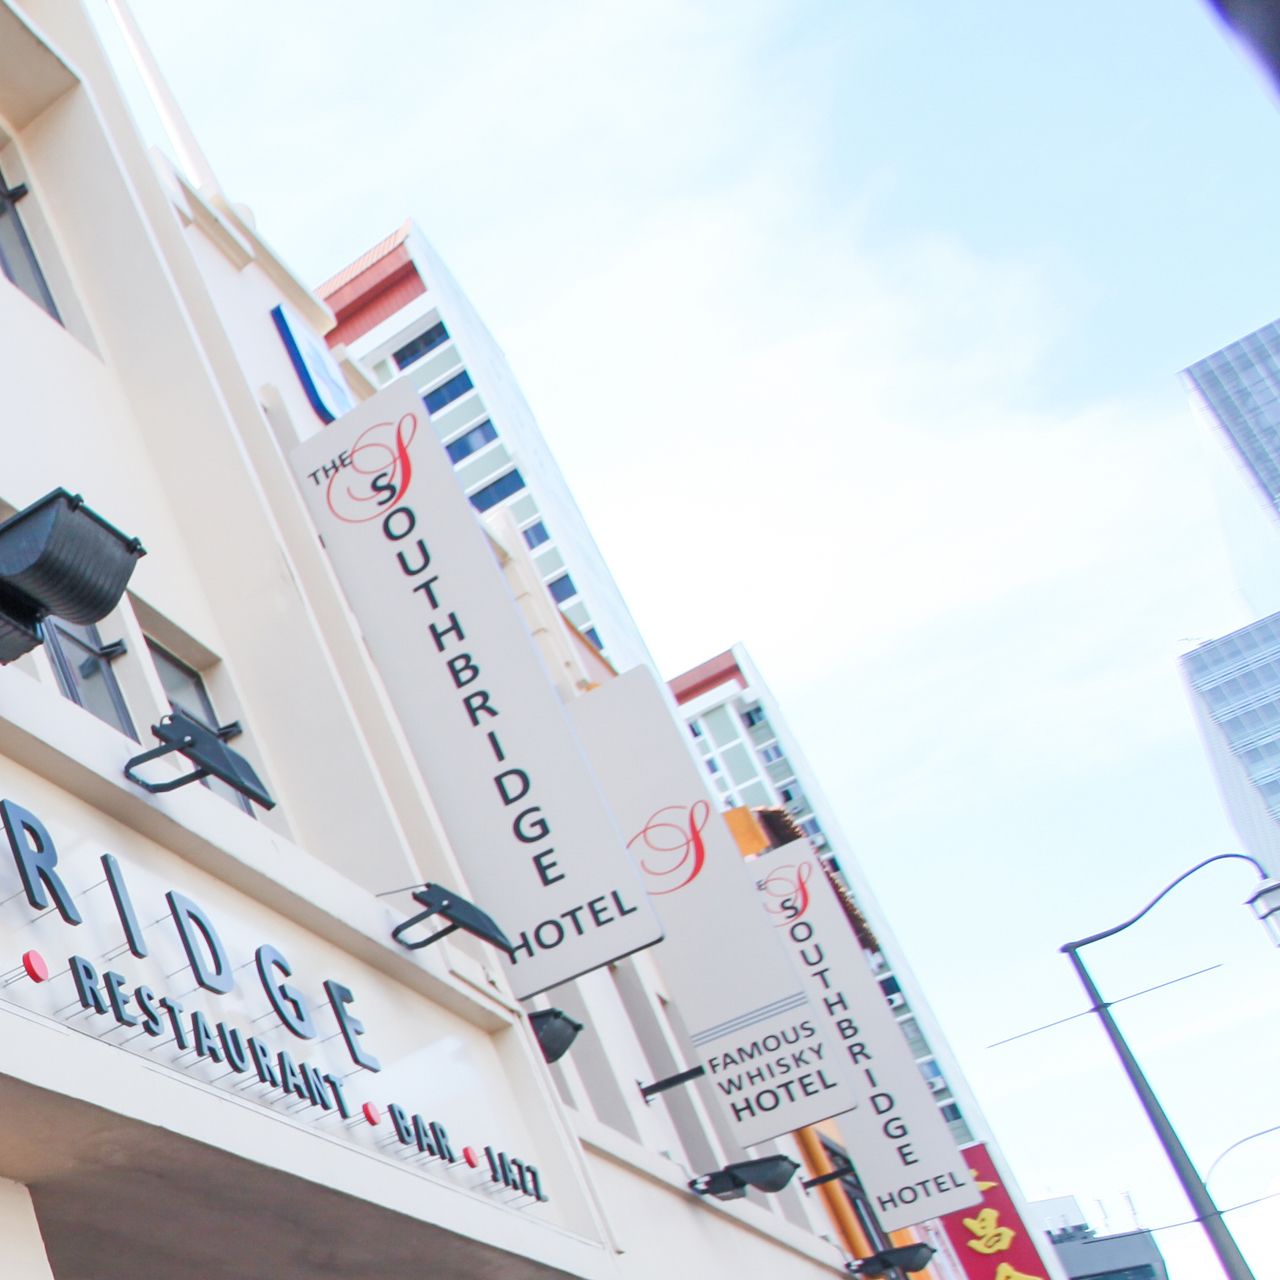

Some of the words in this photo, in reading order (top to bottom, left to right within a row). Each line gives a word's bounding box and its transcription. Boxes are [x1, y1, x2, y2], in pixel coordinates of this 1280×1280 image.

[308, 450, 352, 487] THE
[370, 472, 565, 887] SOUTHBRIDGE
[507, 890, 638, 965] HOTEL
[708, 1020, 816, 1074] FAMOUS
[780, 897, 920, 1167] SOUTHBRIDGE
[68, 954, 352, 1120] RESTAURANT
[387, 1103, 458, 1164] BAR
[485, 1145, 550, 1203] JAZZ
[717, 1042, 824, 1096] WHISKY
[730, 1069, 838, 1122] HOTEL
[876, 1171, 967, 1212] HOTEL
